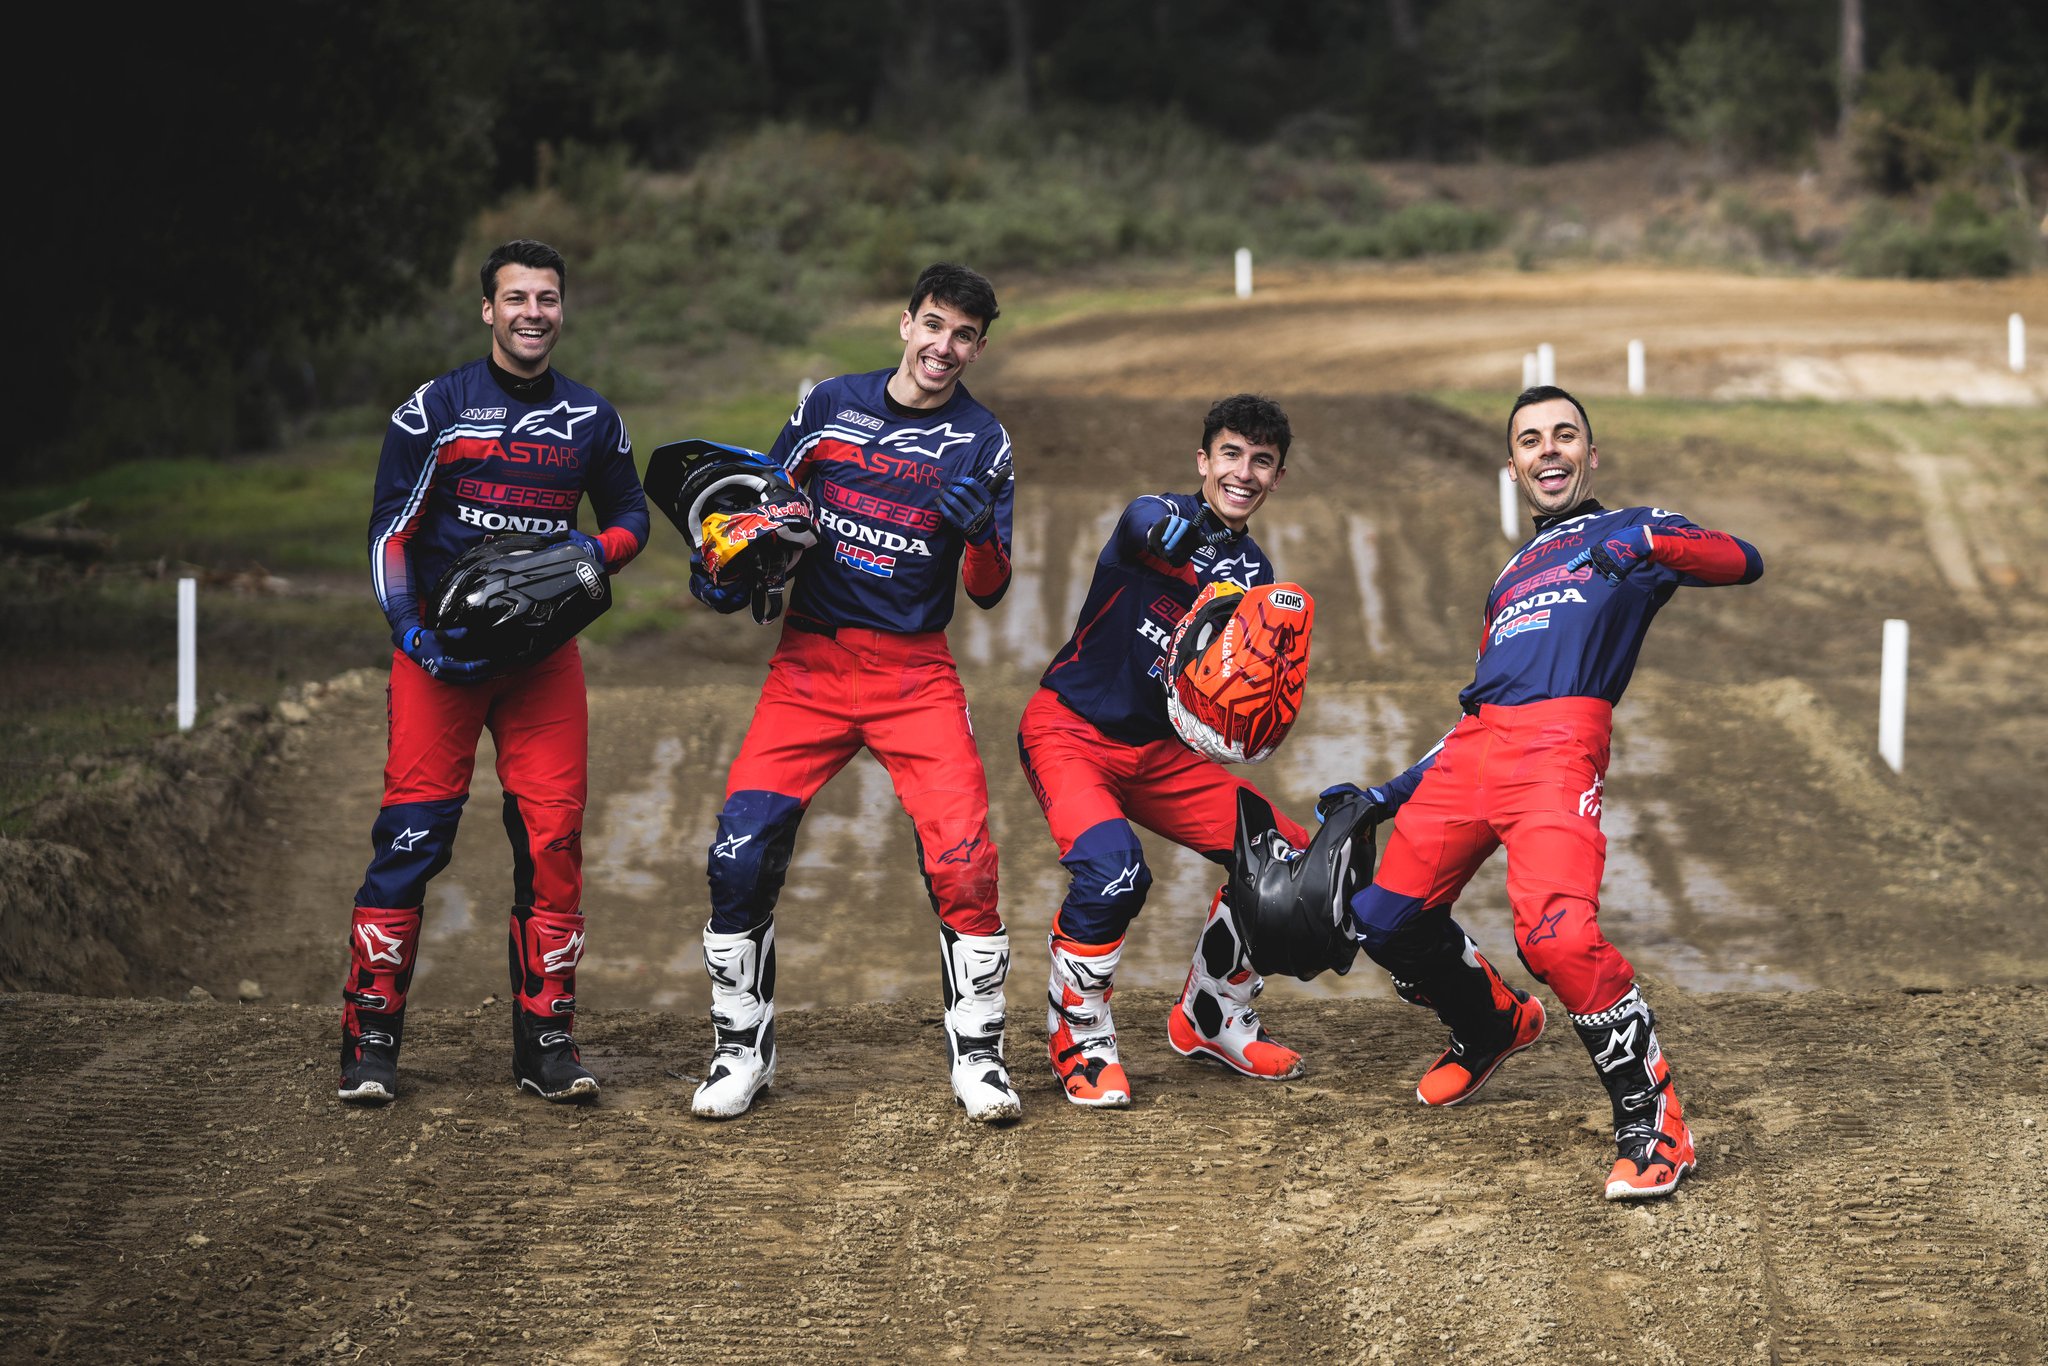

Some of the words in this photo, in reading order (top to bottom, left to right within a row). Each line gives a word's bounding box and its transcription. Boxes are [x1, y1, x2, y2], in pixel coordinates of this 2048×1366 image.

[460, 407, 507, 420] AM73
[836, 409, 885, 431] AM73
[484, 439, 579, 469] ASTARS
[842, 446, 942, 489] ASTARS
[459, 480, 579, 507] BLUEREDS
[824, 483, 942, 529] BLUEREDS
[457, 504, 569, 534] HONDA
[819, 507, 932, 556] HONDA
[834, 540, 897, 578] HRC
[578, 565, 602, 597] SHOEI
[1275, 593, 1302, 609] SHOEI
[1495, 609, 1551, 646] HRC
